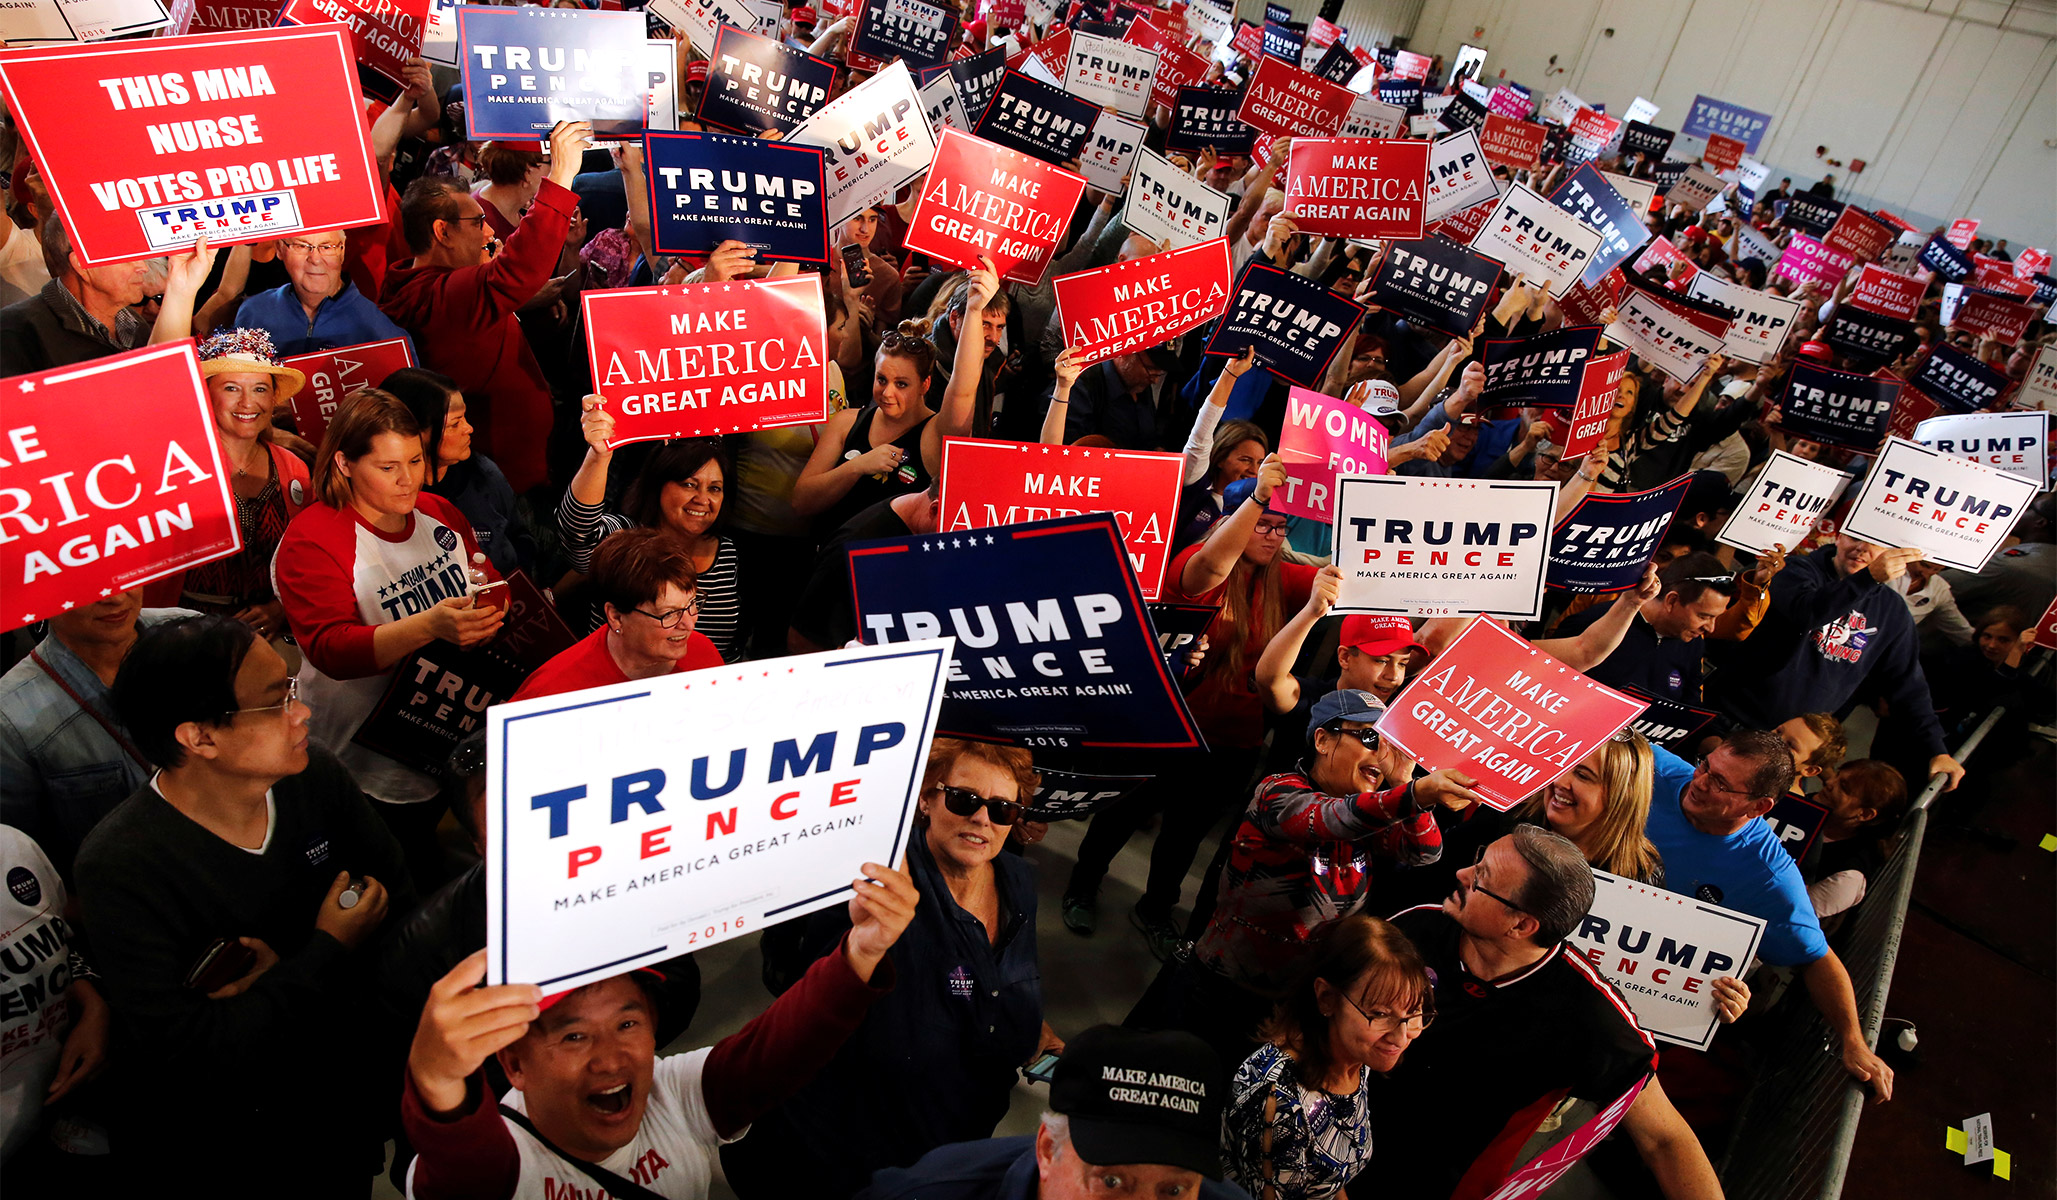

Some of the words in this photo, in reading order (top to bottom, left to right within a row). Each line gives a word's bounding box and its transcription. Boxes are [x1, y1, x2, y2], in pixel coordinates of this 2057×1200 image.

[895, 0, 939, 17] TRUMP
[82, 29, 106, 38] 2016
[312, 0, 367, 34] GREAT
[365, 27, 414, 65] AGAIN
[870, 7, 947, 42] TRUMP
[872, 23, 936, 52] PENCE
[1153, 41, 1180, 64] MAKE
[1264, 31, 1301, 51] TRUMP
[720, 54, 827, 105] TRUMP
[1076, 53, 1150, 81] TRUMP
[1079, 69, 1141, 91] PENCE
[98, 72, 190, 111] THIS
[192, 64, 276, 102] MNA
[488, 95, 514, 104] MAKE
[518, 96, 559, 104] AMERICA
[726, 79, 814, 118] PENCE
[1288, 79, 1322, 101] MAKE
[1380, 89, 1420, 98] TRUMP
[1496, 86, 1533, 112] WOMEN
[1001, 93, 1086, 138] TRUMP
[1250, 82, 1341, 132] AMERICA
[1251, 103, 1290, 132] GREAT
[1290, 121, 1328, 139] AGAIN
[1697, 103, 1763, 131] TRUMP
[146, 114, 262, 155] NURSE
[999, 112, 1071, 148] PENCE
[1183, 120, 1246, 132] PENCE
[1505, 125, 1526, 136] MAKE
[1696, 117, 1752, 139] PENCE
[1482, 130, 1539, 154] AMERICA
[1483, 142, 1508, 155] GREAT
[1508, 149, 1533, 162] AGAIN
[1331, 155, 1378, 170] MAKE
[90, 170, 203, 211] VOTES
[205, 162, 274, 196] PRO
[278, 153, 341, 188] LIFE
[659, 167, 816, 201] TRUMP
[990, 168, 1042, 200] MAKE
[1288, 175, 1421, 202] AMERICA
[153, 197, 280, 225] TRUMP
[676, 193, 802, 218] PENCE
[867, 189, 889, 205] 2016
[926, 177, 1062, 243] AMERICA
[1140, 172, 1218, 225] TRUMP
[1792, 200, 1837, 219] TRUMP
[171, 212, 273, 234] PENCE
[673, 213, 698, 222] MAKE
[701, 215, 741, 224] AMERICA
[744, 217, 774, 227] GREAT
[776, 220, 807, 230] AGAIN!
[1142, 193, 1206, 235] PENCE
[1294, 204, 1349, 220] GREAT
[1353, 206, 1410, 221] AGAIN
[1567, 179, 1629, 252] TRUMP
[930, 213, 998, 250] GREAT
[998, 239, 1045, 263] AGAIN
[1500, 225, 1570, 270] PENCE
[1503, 206, 1586, 262] TRUMP
[1791, 236, 1852, 270] WOMEN
[1801, 258, 1824, 273] FOR
[1928, 241, 1967, 275] TRUMP
[1393, 248, 1488, 296] TRUMP
[1781, 262, 1832, 291] TRUMP
[1881, 278, 1902, 289] MAKE
[1113, 273, 1173, 303] MAKE
[1386, 281, 1402, 291] MAKE
[1403, 288, 1429, 302] AMERICA
[1430, 298, 1448, 311] GREAT
[1449, 307, 1469, 318] AGAIN!
[1392, 270, 1473, 308] PENCE
[1857, 281, 1917, 307] AMERICA
[1071, 281, 1226, 349] AMERICA
[1238, 289, 1342, 339] TRUMP
[1857, 293, 1882, 306] GREAT
[1883, 302, 1910, 314] AGAIN
[670, 309, 747, 335] MAKE
[1085, 330, 1146, 363] GREAT
[1151, 304, 1215, 337] AGAIN
[1235, 311, 1320, 351] PENCE
[1628, 306, 1710, 355] TRUMP
[1836, 318, 1904, 344] TRUMP
[1241, 327, 1267, 338] AMERICA
[1268, 335, 1289, 349] GREAT
[1290, 346, 1314, 361] AGAIN!
[1627, 318, 1693, 360] PENCE
[1836, 330, 1892, 351] PENCE
[602, 335, 821, 387] AMERICA
[1488, 348, 1588, 376] TRUMP
[1487, 366, 1572, 386] PENCE
[1927, 368, 1982, 404] PENCE
[1930, 355, 1998, 398] TRUMP
[621, 388, 711, 416] GREAT
[720, 378, 807, 406] AGAIN
[1792, 382, 1891, 414] TRUMP
[1794, 400, 1875, 425] PENCE
[1290, 397, 1388, 462] WOMEN
[1576, 419, 1607, 440] GREAT
[1328, 452, 1368, 475] FOR
[1024, 472, 1101, 498] MAKE
[1760, 480, 1831, 514] TRUMP
[1884, 469, 2012, 521] TRUMP
[1757, 503, 1816, 527] PENCE
[1874, 506, 1896, 518] MAKE
[1897, 514, 1933, 530] AMERICA
[1935, 526, 1958, 537] GREAT
[1959, 532, 1983, 544] AGAIN!
[1883, 493, 1989, 534] PENCE
[1350, 517, 1538, 546] TRUMP
[1566, 511, 1673, 546] TRUMP
[23, 502, 194, 585] AGAIN
[1363, 549, 1515, 567] PENCE
[1559, 538, 1655, 560] PENCE
[403, 564, 428, 588] TEAM
[1357, 571, 1386, 579] MAKE
[1390, 571, 1438, 580] AMERICA
[1442, 572, 1476, 580] GREAT
[1480, 572, 1518, 581] AGAIN!
[1571, 558, 1605, 569] AMERICA
[1606, 558, 1628, 568] GREAT
[1571, 585, 1596, 594] 2016
[865, 593, 1123, 649] TRUMP
[1417, 606, 1449, 616] 2016
[953, 688, 1016, 700] AMERICA
[1020, 685, 1068, 698] GREAT
[1075, 684, 1133, 696] AGAIN!
[1505, 670, 1570, 714] MAKE
[398, 709, 423, 726] MAKE
[423, 721, 460, 742] AMERICA
[1422, 664, 1583, 768] AMERICA
[1024, 737, 1069, 748] 2016
[1411, 700, 1483, 753] GREAT
[1472, 744, 1540, 786] AGAIN
[530, 721, 906, 840] TRUMP
[567, 778, 862, 879] PENCE
[305, 840, 329, 859] TRUMP
[553, 883, 617, 911] MAKE
[626, 854, 720, 892] AMERICA
[728, 832, 790, 861] GREAT
[797, 814, 864, 840] AGAIN!
[687, 916, 745, 945] 2016
[1624, 980, 1659, 998] GREAT
[1661, 991, 1700, 1008] AGAIN!
[1102, 1066, 1146, 1085] MAKE
[1147, 1071, 1206, 1097] AMERICA
[1108, 1087, 1159, 1106] GREAT
[1159, 1093, 1199, 1115] AGAIN
